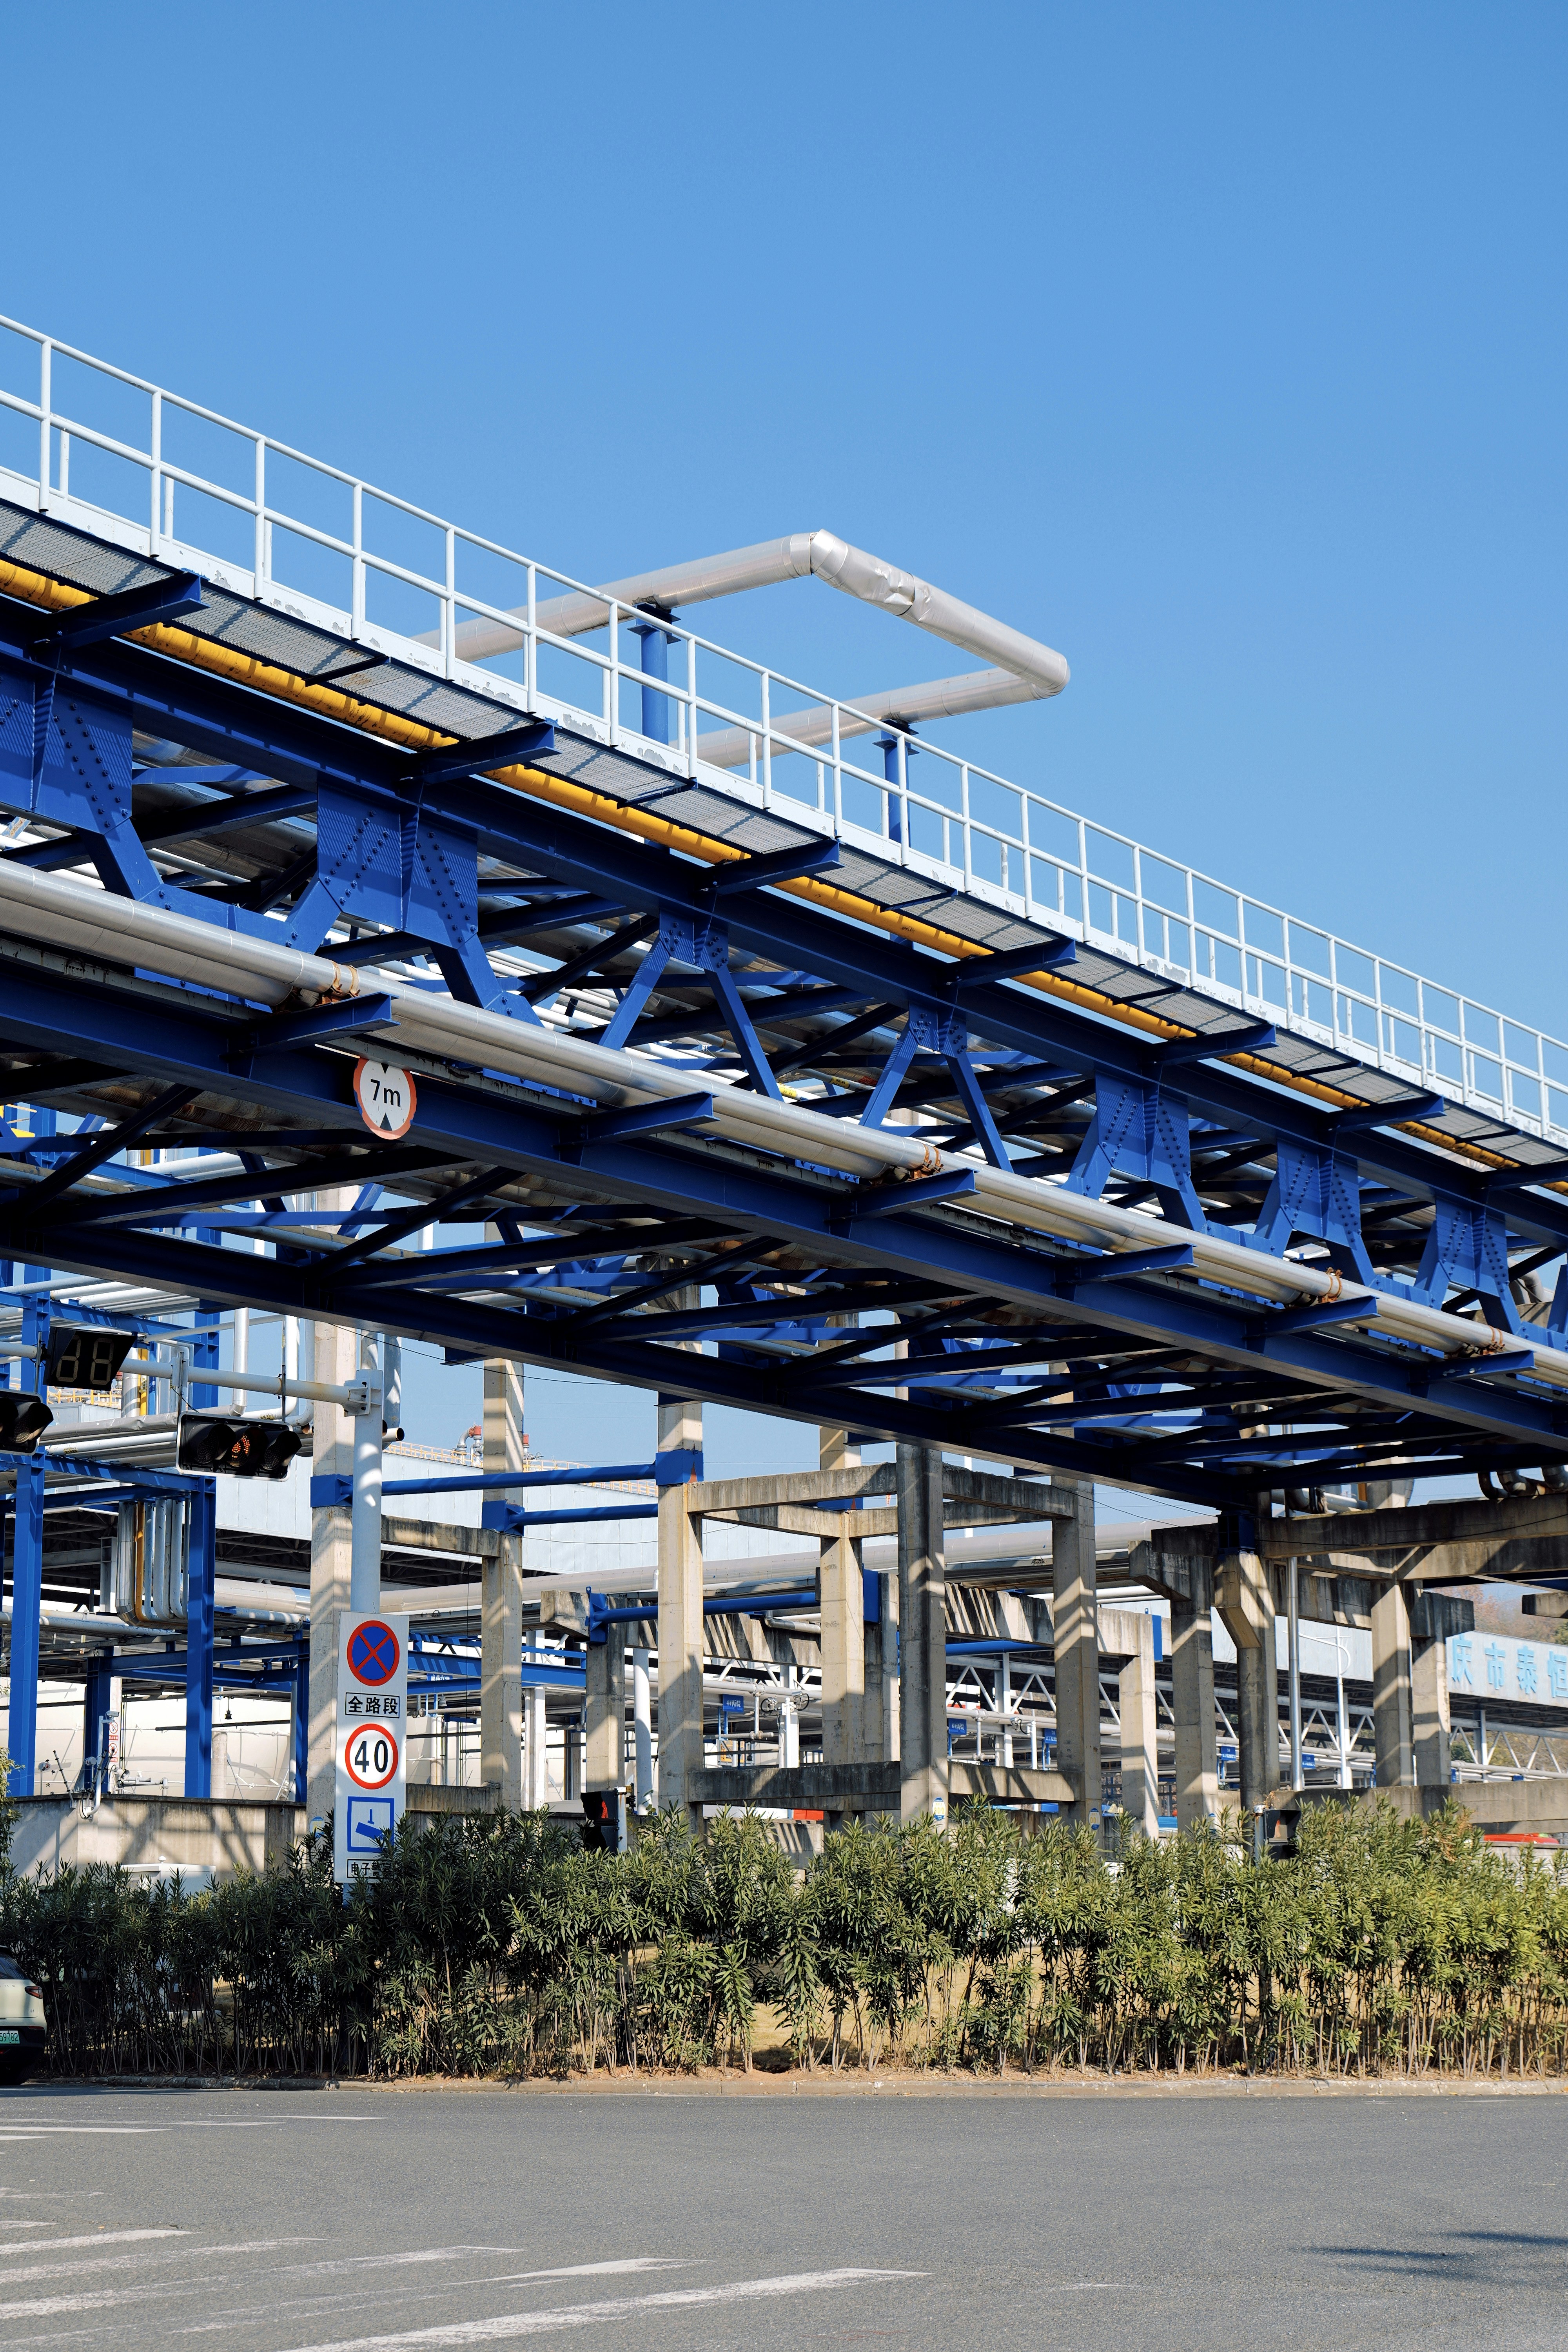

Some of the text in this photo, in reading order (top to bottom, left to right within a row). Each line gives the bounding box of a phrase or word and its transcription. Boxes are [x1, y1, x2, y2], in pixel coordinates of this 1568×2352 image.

[370, 1079, 401, 1107] 7m
[348, 1696, 398, 1715] 全路段
[355, 1740, 388, 1773] 40
